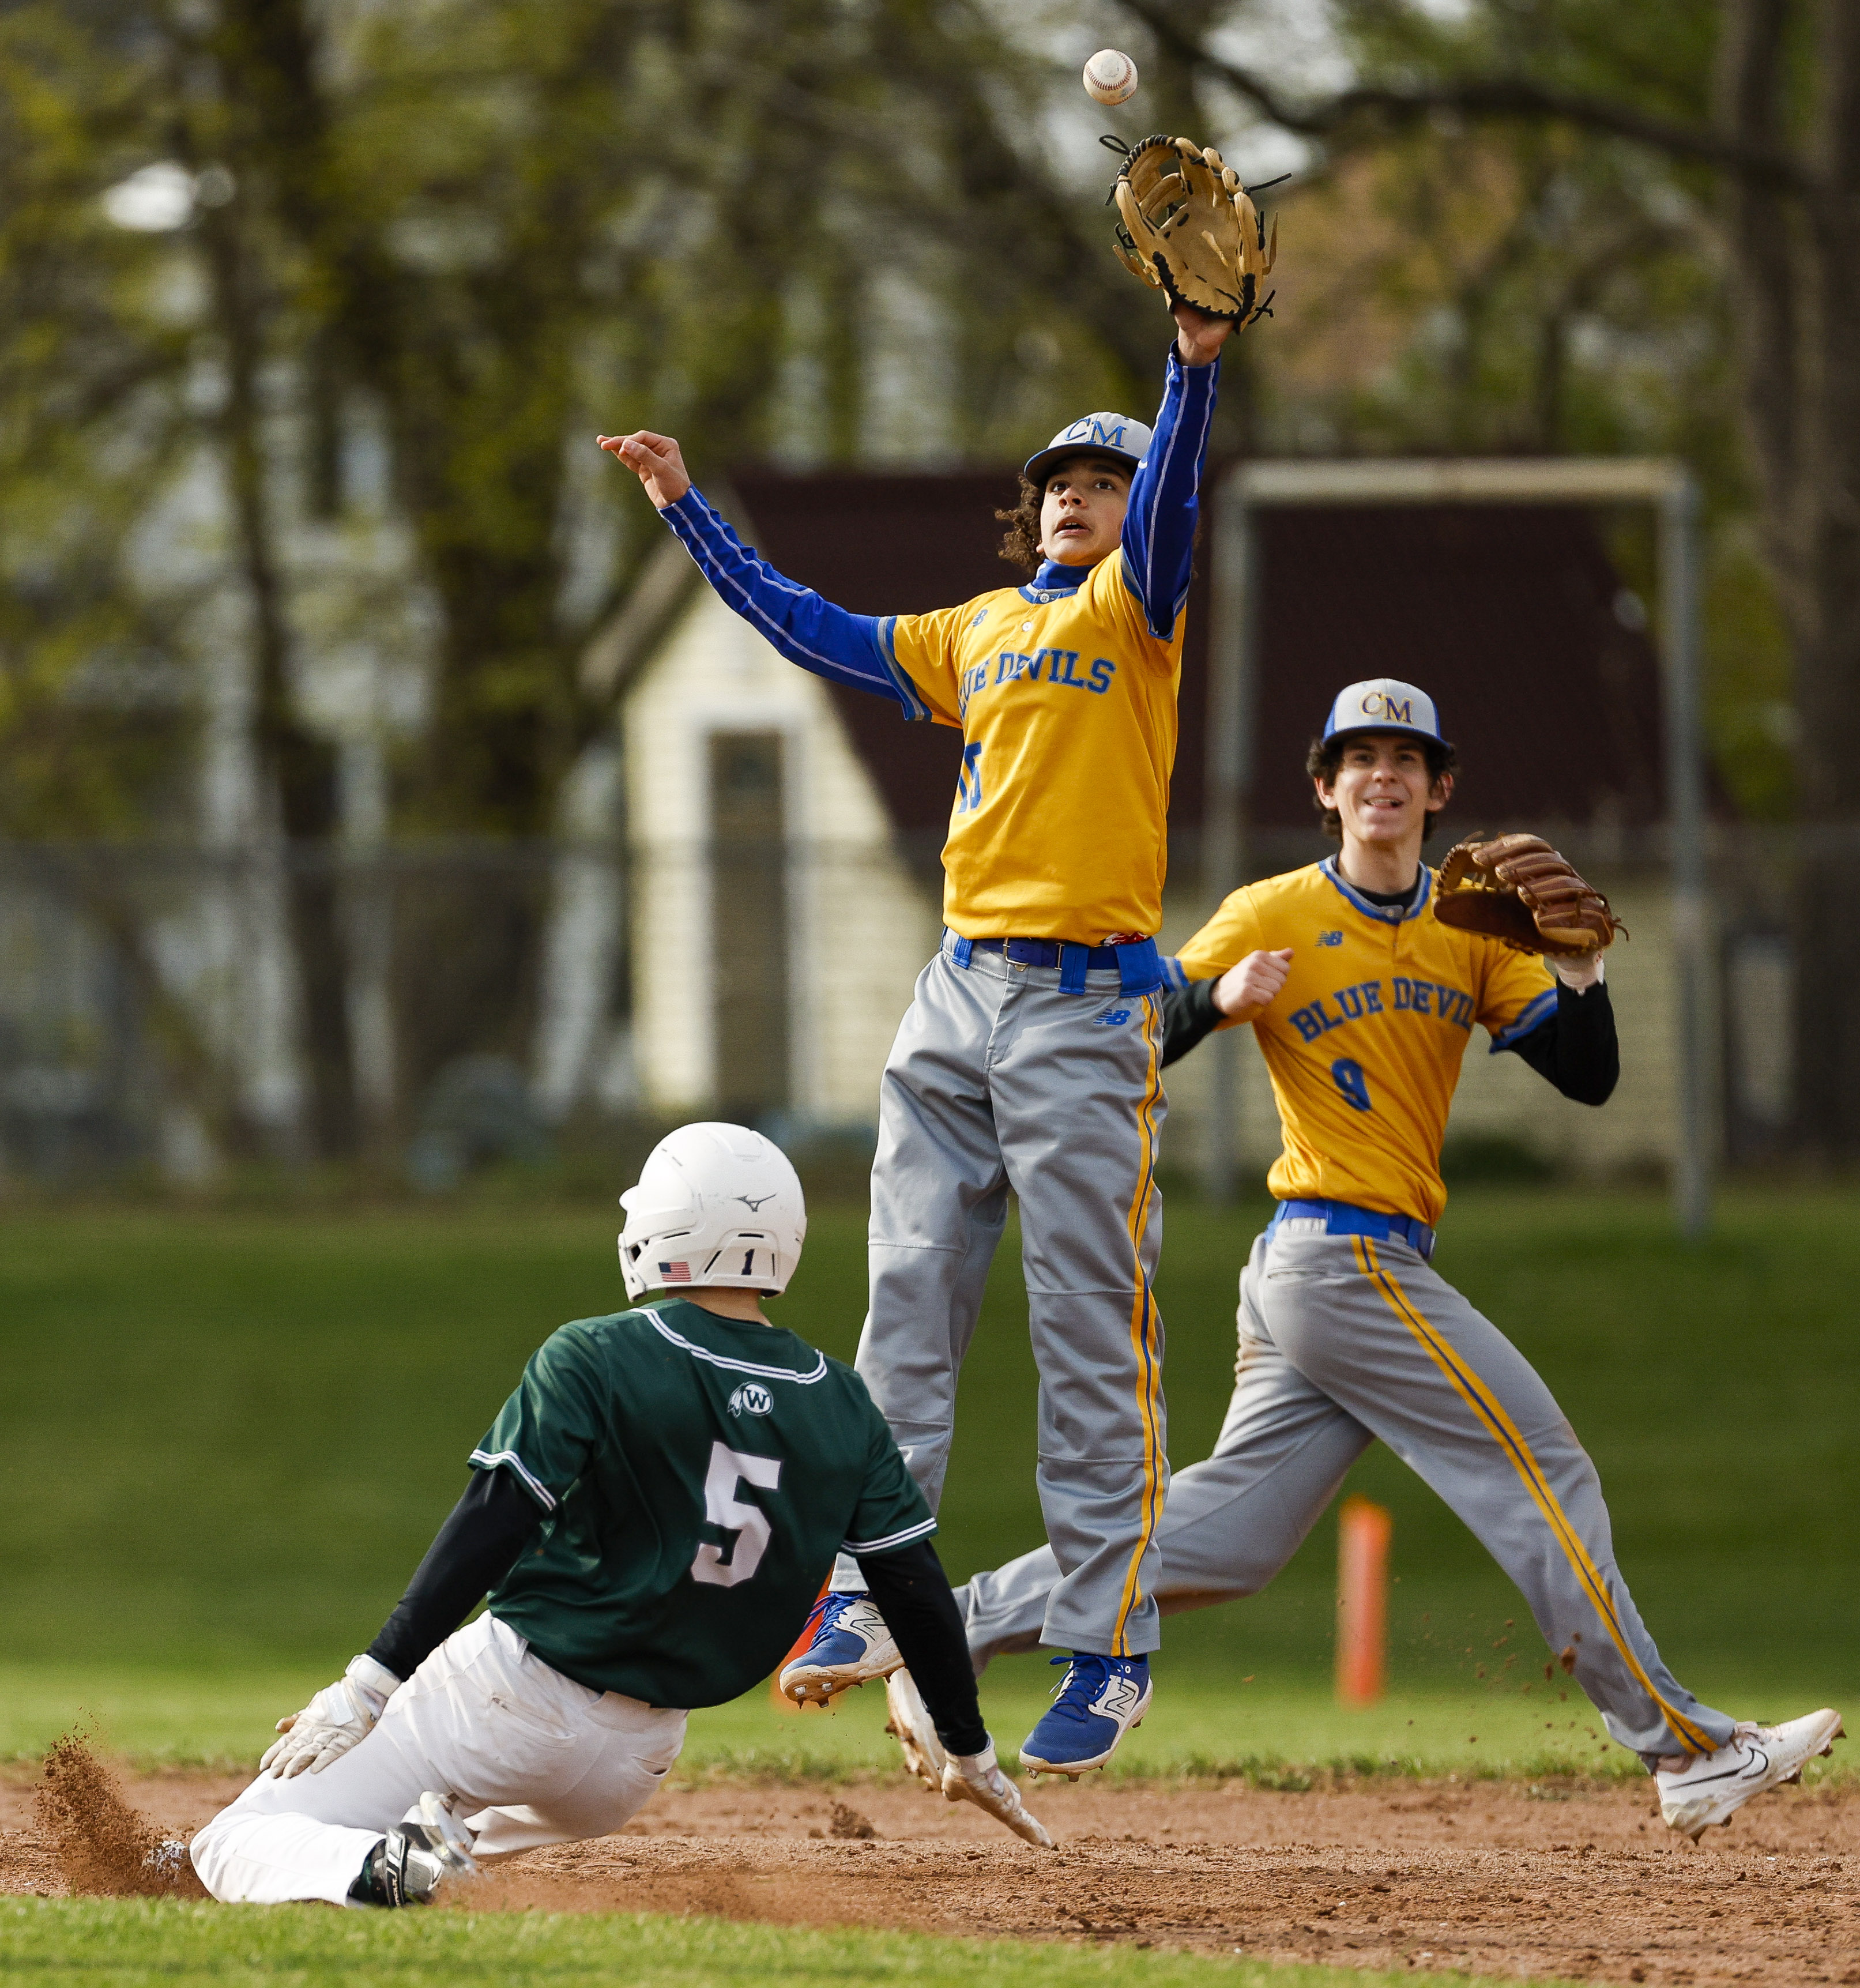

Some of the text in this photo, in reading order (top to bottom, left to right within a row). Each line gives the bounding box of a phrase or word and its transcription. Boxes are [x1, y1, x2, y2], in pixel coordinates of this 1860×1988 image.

[1064, 417, 1127, 448] CM
[995, 647, 1116, 695] DEVILS
[1360, 690, 1413, 724] CM
[1287, 980, 1384, 1044] BLUE
[1331, 1057, 1372, 1112] 9
[741, 1248, 755, 1276] 1
[744, 1389, 770, 1410] W
[691, 1440, 784, 1588] 5
